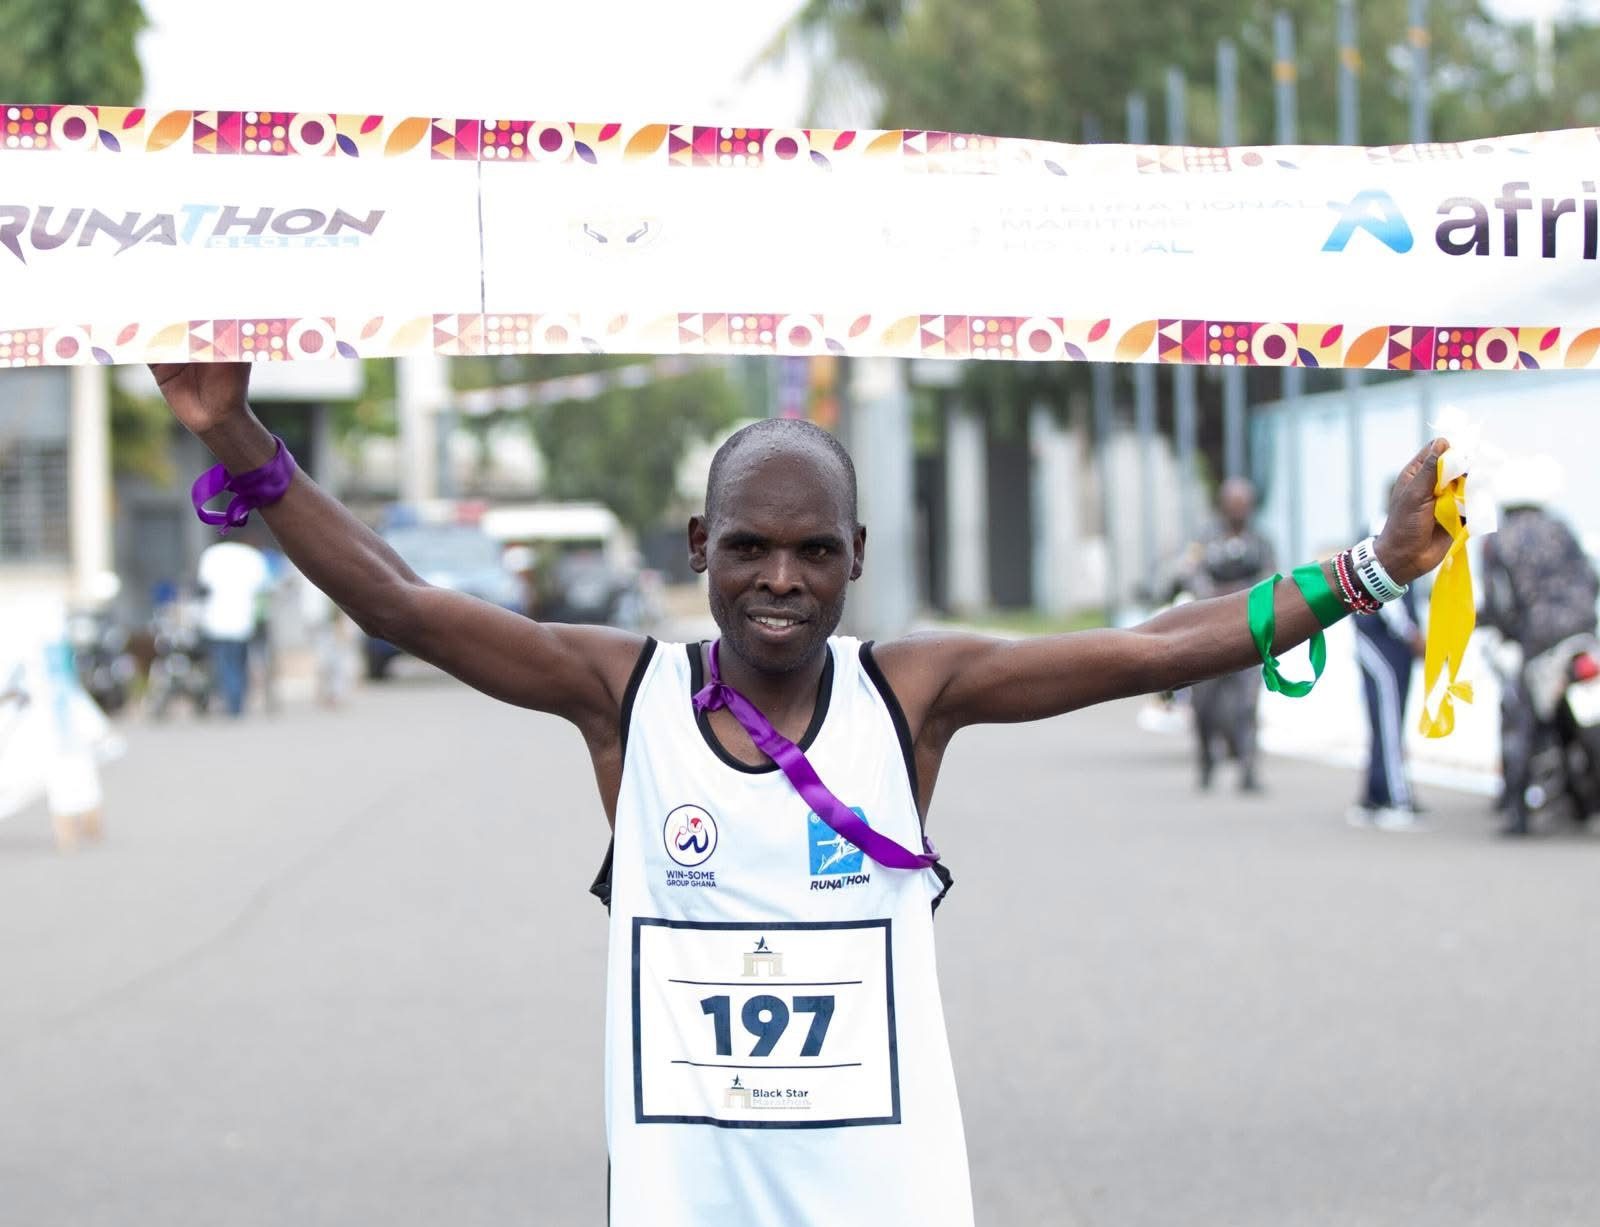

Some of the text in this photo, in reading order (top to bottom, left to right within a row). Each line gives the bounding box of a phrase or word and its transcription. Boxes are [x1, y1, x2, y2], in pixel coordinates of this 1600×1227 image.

[0, 204, 385, 265] RUNATHON
[666, 870, 715, 880] WIN-SOME
[666, 879, 717, 888] GROUP GHANA
[810, 874, 870, 890] RUNATHON
[700, 995, 835, 1057] 197
[752, 1088, 809, 1098] Black Star
